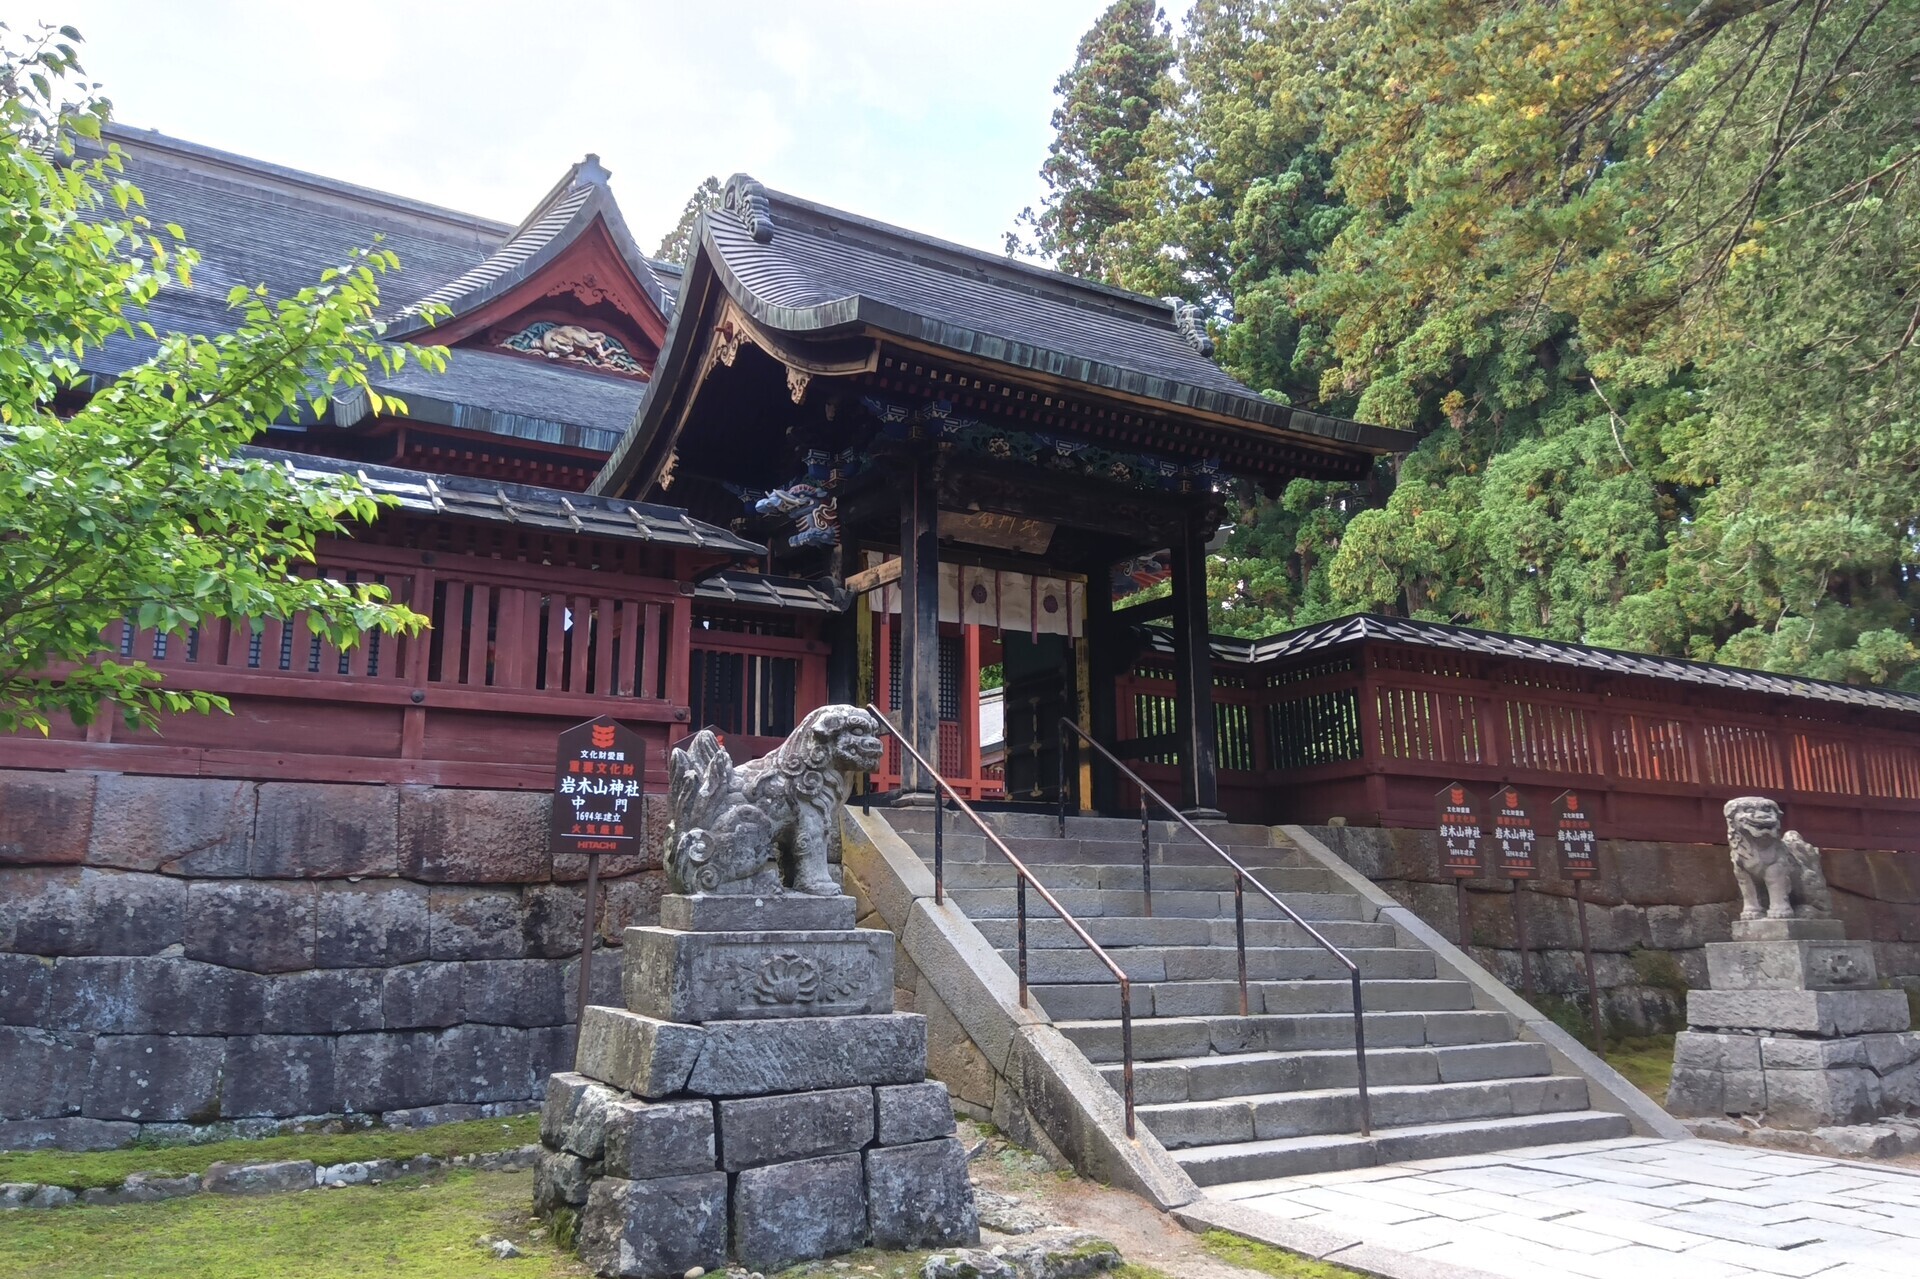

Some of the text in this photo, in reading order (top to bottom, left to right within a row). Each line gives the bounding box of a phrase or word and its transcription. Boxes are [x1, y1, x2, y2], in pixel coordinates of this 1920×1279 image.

[569, 760, 634, 775] 重要文化財
[560, 776, 639, 797] 岩木山神社
[576, 811, 621, 822] 1694年建立
[1440, 825, 1481, 838] 岩木山神社
[1495, 827, 1536, 841] 岩木山神社
[1557, 829, 1596, 842] 岩木山神社
[578, 841, 617, 849] HITACHI
